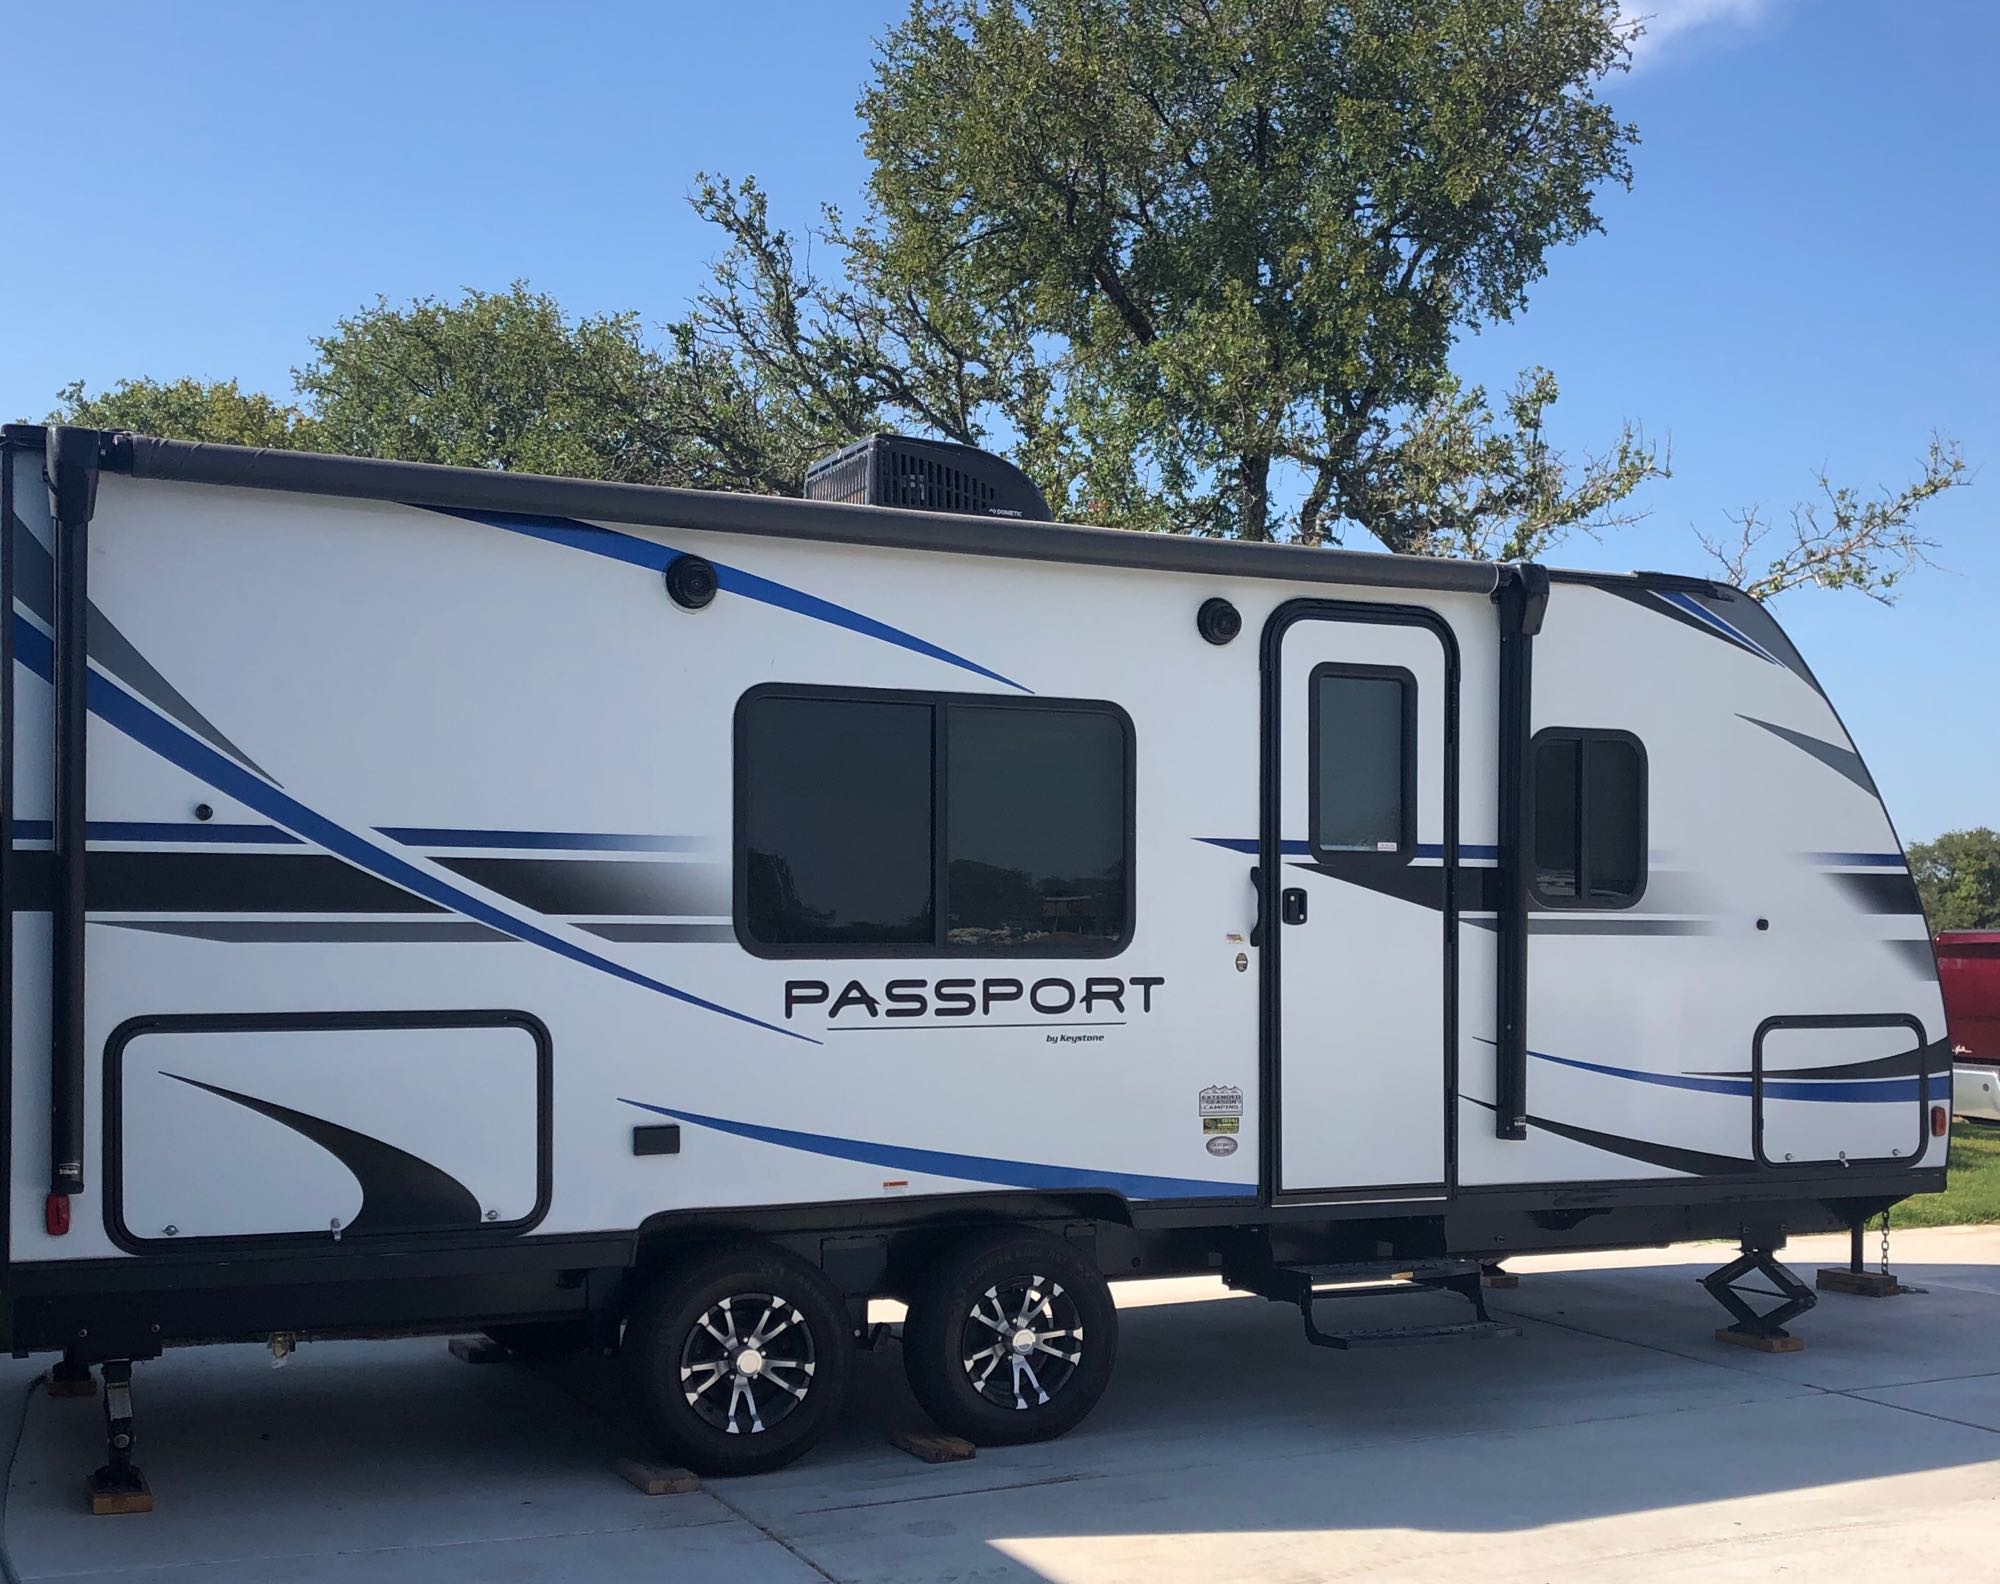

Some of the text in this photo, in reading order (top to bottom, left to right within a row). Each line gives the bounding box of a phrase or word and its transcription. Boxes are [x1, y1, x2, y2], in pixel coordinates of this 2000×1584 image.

[996, 508, 1022, 517] DOMETIC
[785, 976, 1165, 1019] PASSPORT
[1046, 1034, 1105, 1044] by Keystone
